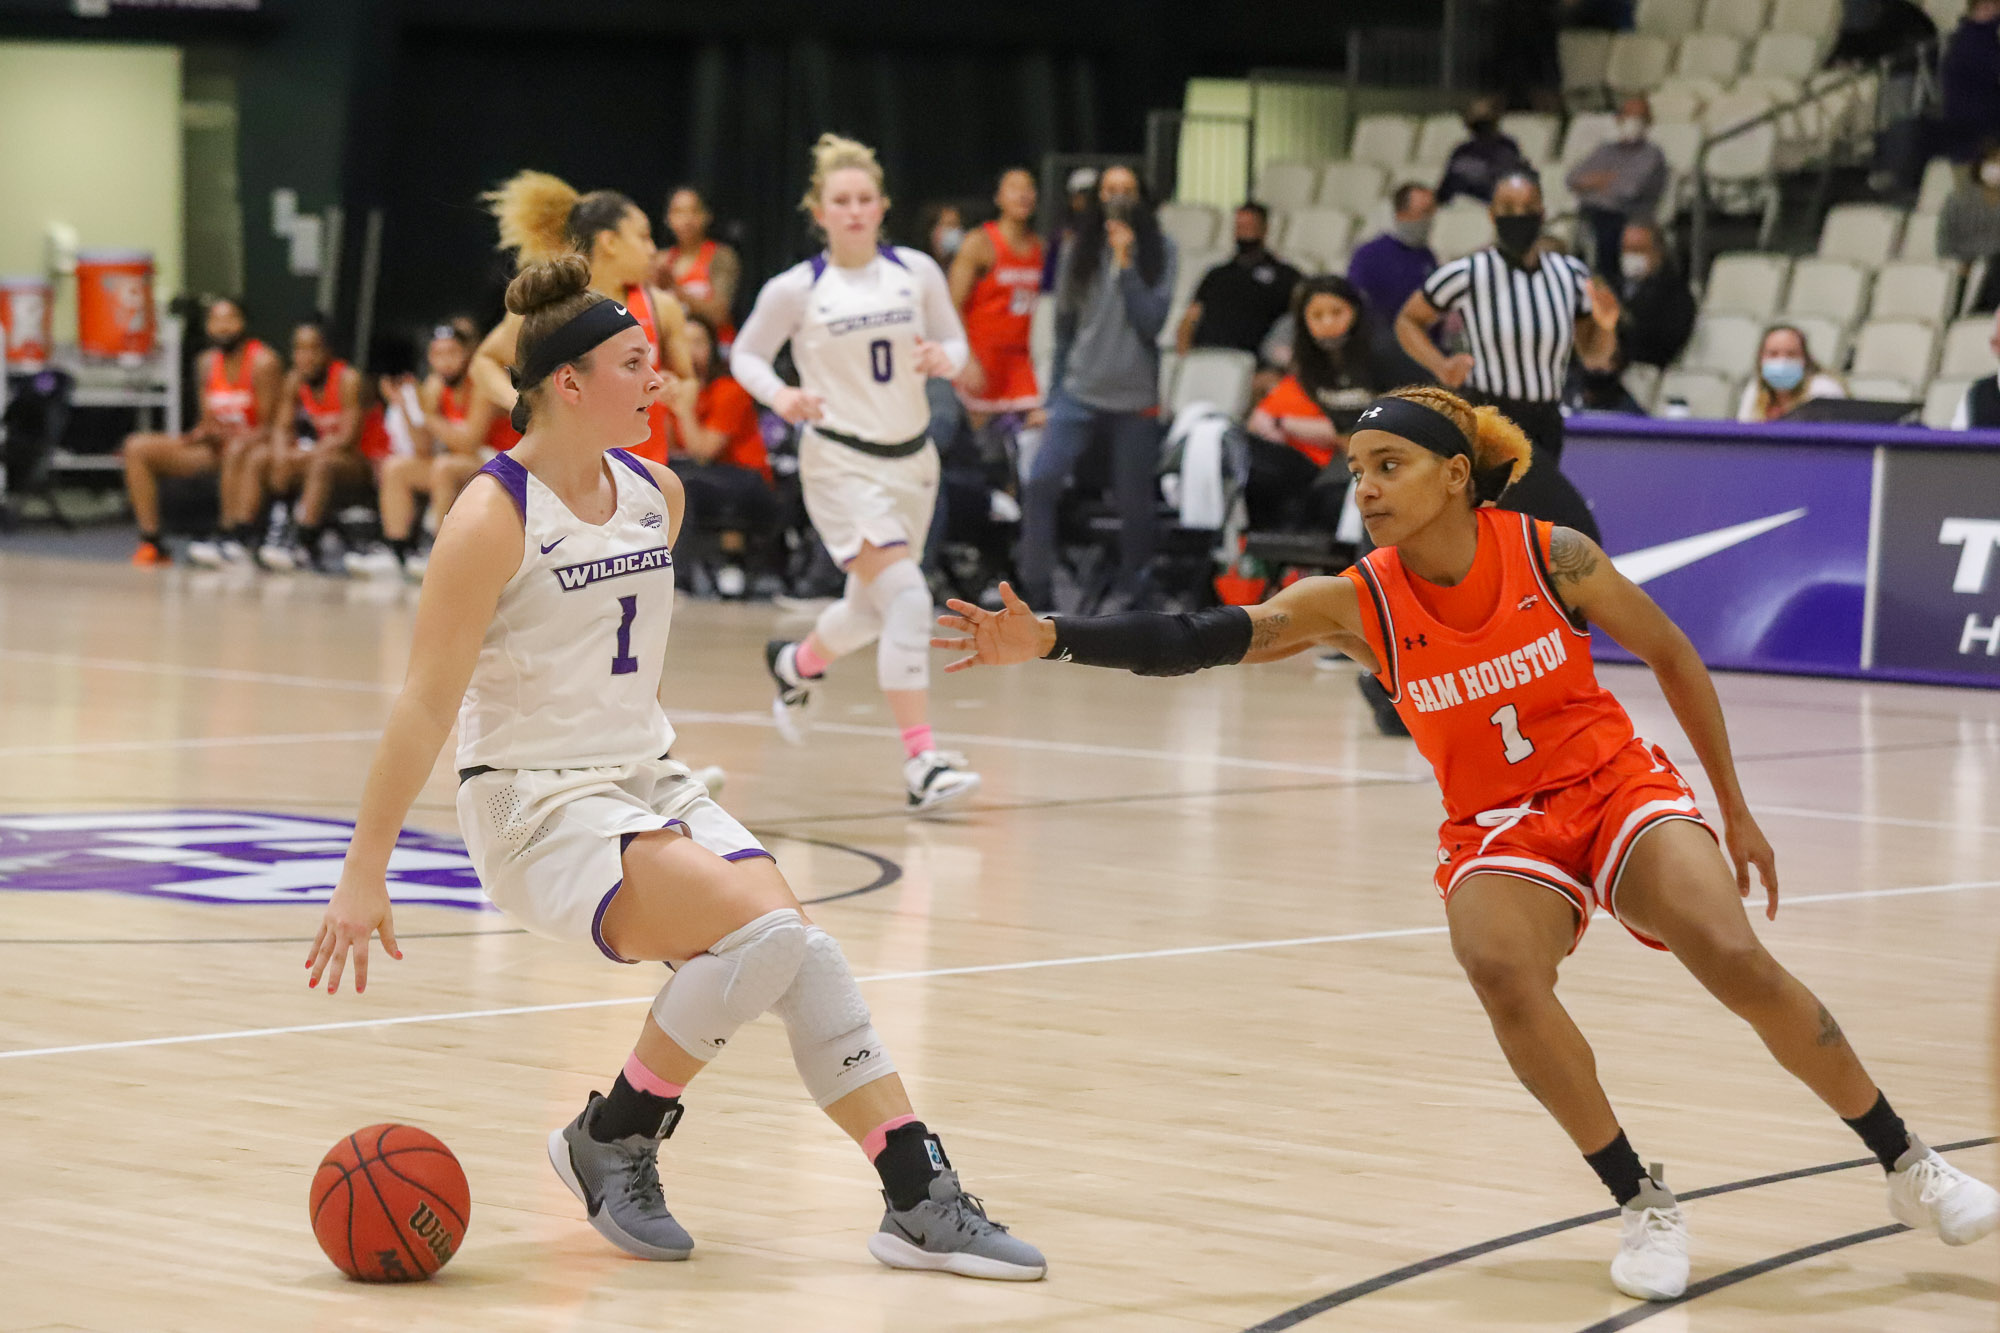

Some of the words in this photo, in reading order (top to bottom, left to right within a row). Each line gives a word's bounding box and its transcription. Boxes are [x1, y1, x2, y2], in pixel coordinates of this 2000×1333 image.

[870, 339, 892, 383] 0
[556, 547, 673, 591] WILDCATS
[611, 594, 638, 676] 1
[1407, 672, 1464, 713] SAM
[1458, 628, 1568, 701] HOUSTON
[1489, 703, 1536, 765] 1
